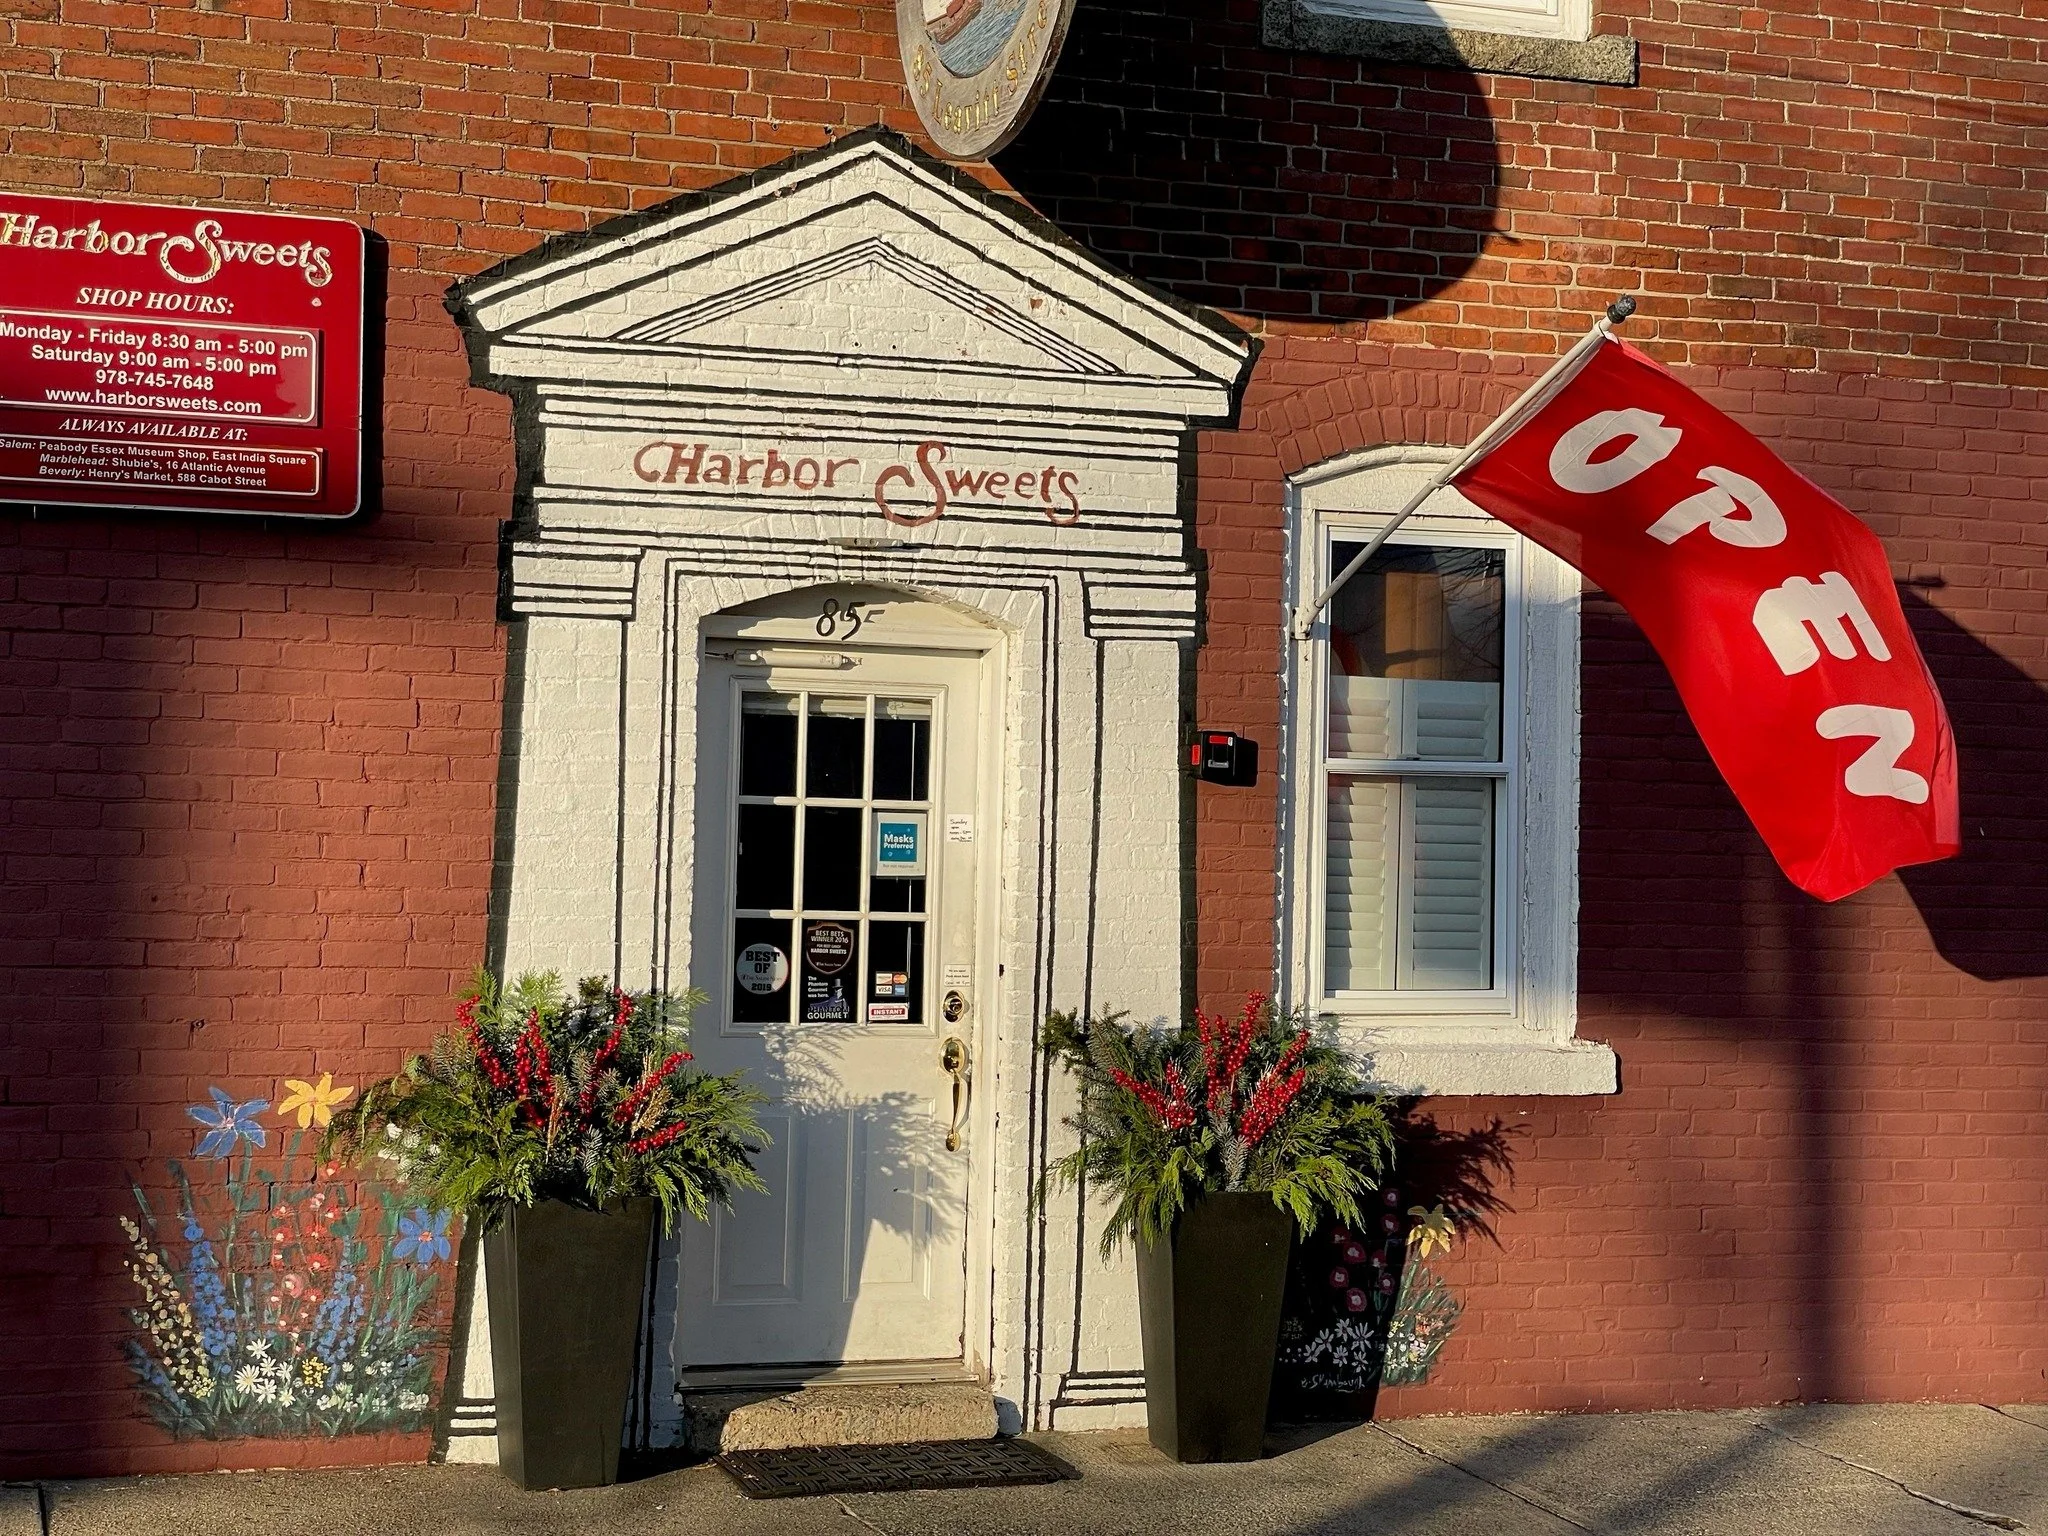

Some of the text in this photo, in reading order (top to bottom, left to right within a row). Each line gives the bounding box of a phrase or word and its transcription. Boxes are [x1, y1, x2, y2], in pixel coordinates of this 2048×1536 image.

[0, 213, 334, 288] Harbor Sweets
[77, 287, 235, 315] SHOP HOURS:
[0, 322, 73, 344] Monday
[89, 328, 147, 350] Friday
[151, 332, 190, 349] 8:30
[194, 338, 222, 351] am
[238, 339, 276, 355] 5:00
[281, 345, 308, 359] pm
[31, 345, 114, 367] Saturday
[119, 350, 157, 367] 9:00
[162, 356, 189, 369] am
[205, 356, 244, 373] 5:00
[249, 362, 277, 377] pm
[95, 369, 214, 391] 978-745-7648
[45, 388, 262, 413] www.harborsweets.com
[58, 418, 249, 441] ALWAYS AVAILABLE AT:
[0, 438, 307, 465] Salem: Peabody Essex Museum Shop, East India Square
[39, 453, 266, 474] Marblehead: Shubie's, 16 Atlantic Avenue
[39, 465, 267, 486] Beverly: Henry's Market, 588 Cabot Street
[633, 441, 1080, 527] Harbor Sweets
[1549, 408, 1929, 804] OPEN
[815, 598, 866, 641] 85
[884, 833, 914, 843] Masks
[745, 951, 780, 962] BEST
[754, 963, 770, 973] OF
[751, 983, 772, 992] 2019
